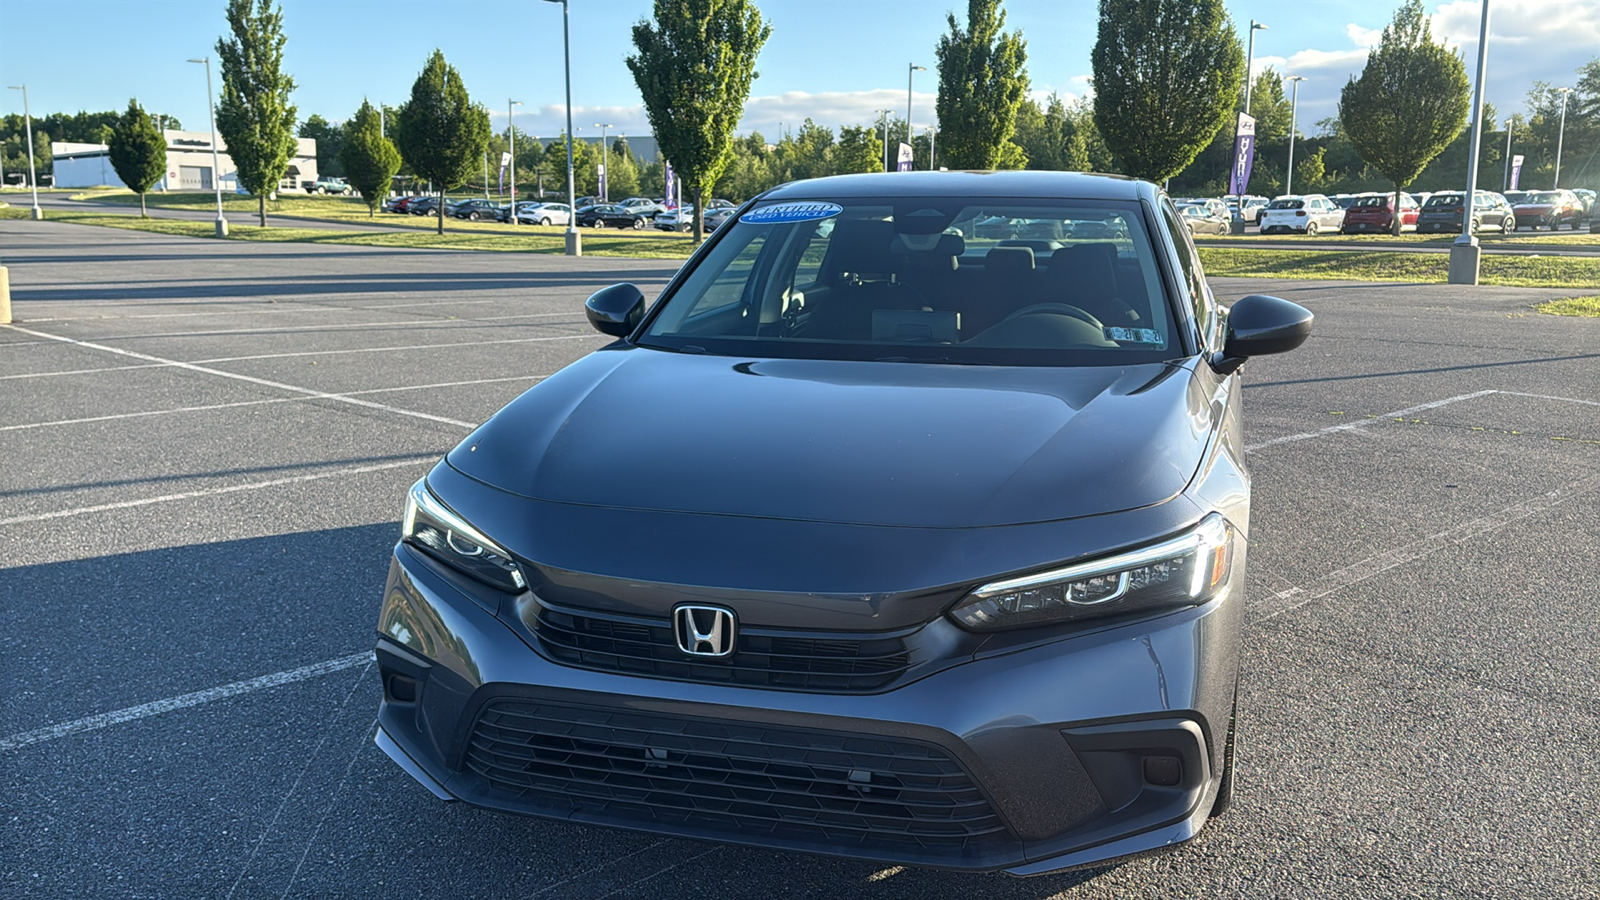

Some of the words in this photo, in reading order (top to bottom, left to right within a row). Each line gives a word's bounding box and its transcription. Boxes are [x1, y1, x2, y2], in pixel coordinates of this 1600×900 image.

[1237, 137, 1250, 194] HYUNDAI
[753, 204, 834, 215] CERTIFIED
[748, 213, 778, 221] USED
[780, 210, 829, 218] VEHICLE
